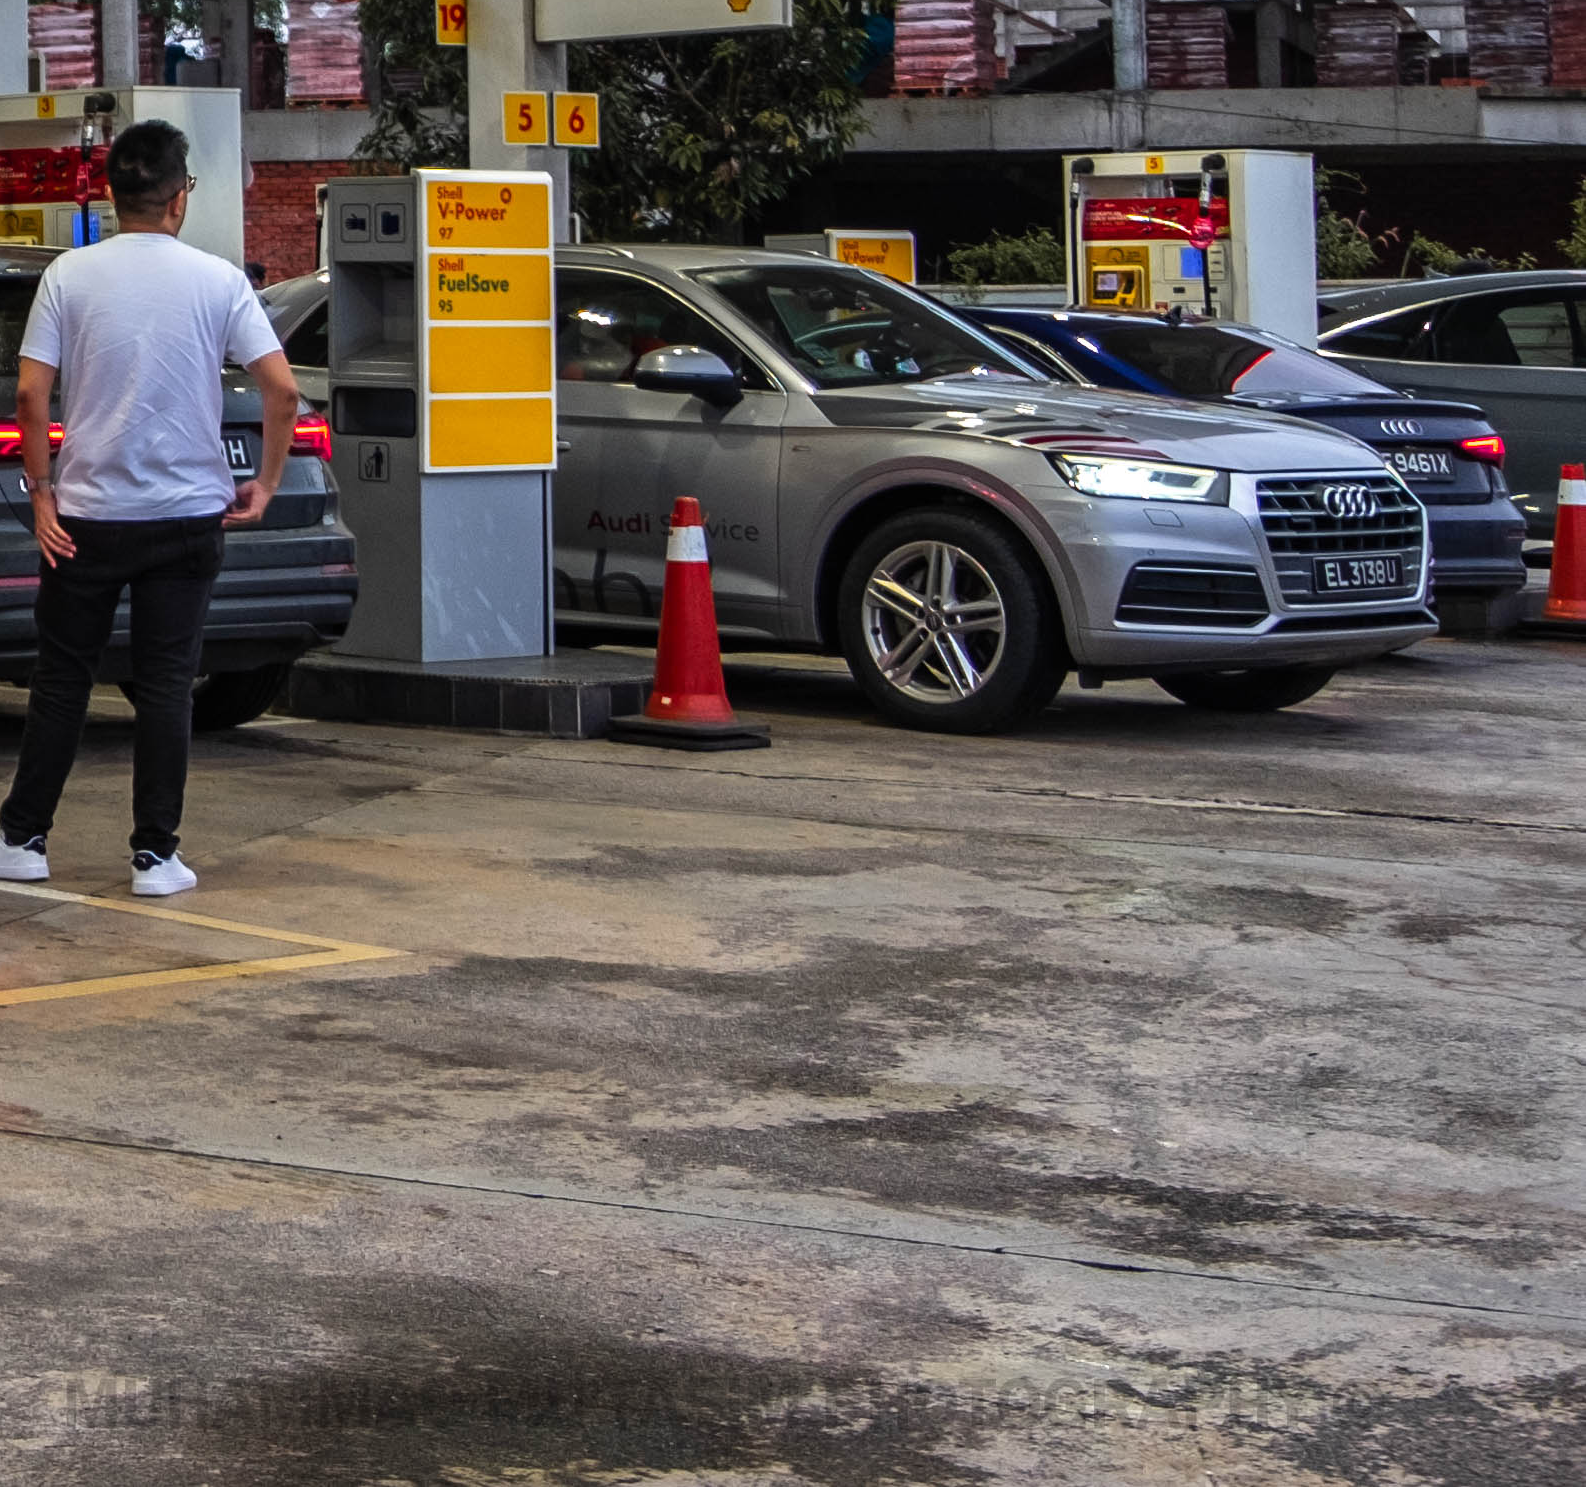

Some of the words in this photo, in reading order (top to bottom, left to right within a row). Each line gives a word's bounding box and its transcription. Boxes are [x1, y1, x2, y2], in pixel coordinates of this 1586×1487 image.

[439, 4, 466, 32] 19
[518, 105, 533, 132] 5
[569, 106, 584, 134] 6
[436, 186, 463, 201] Shell
[437, 203, 507, 222] V-Power
[439, 227, 454, 241] 97
[437, 259, 464, 273] Shell
[437, 274, 510, 293] FuelSave
[438, 300, 453, 313] 95
[588, 511, 650, 533] Audi
[661, 514, 759, 541] Svice
[1325, 559, 1397, 587] EL3138U
